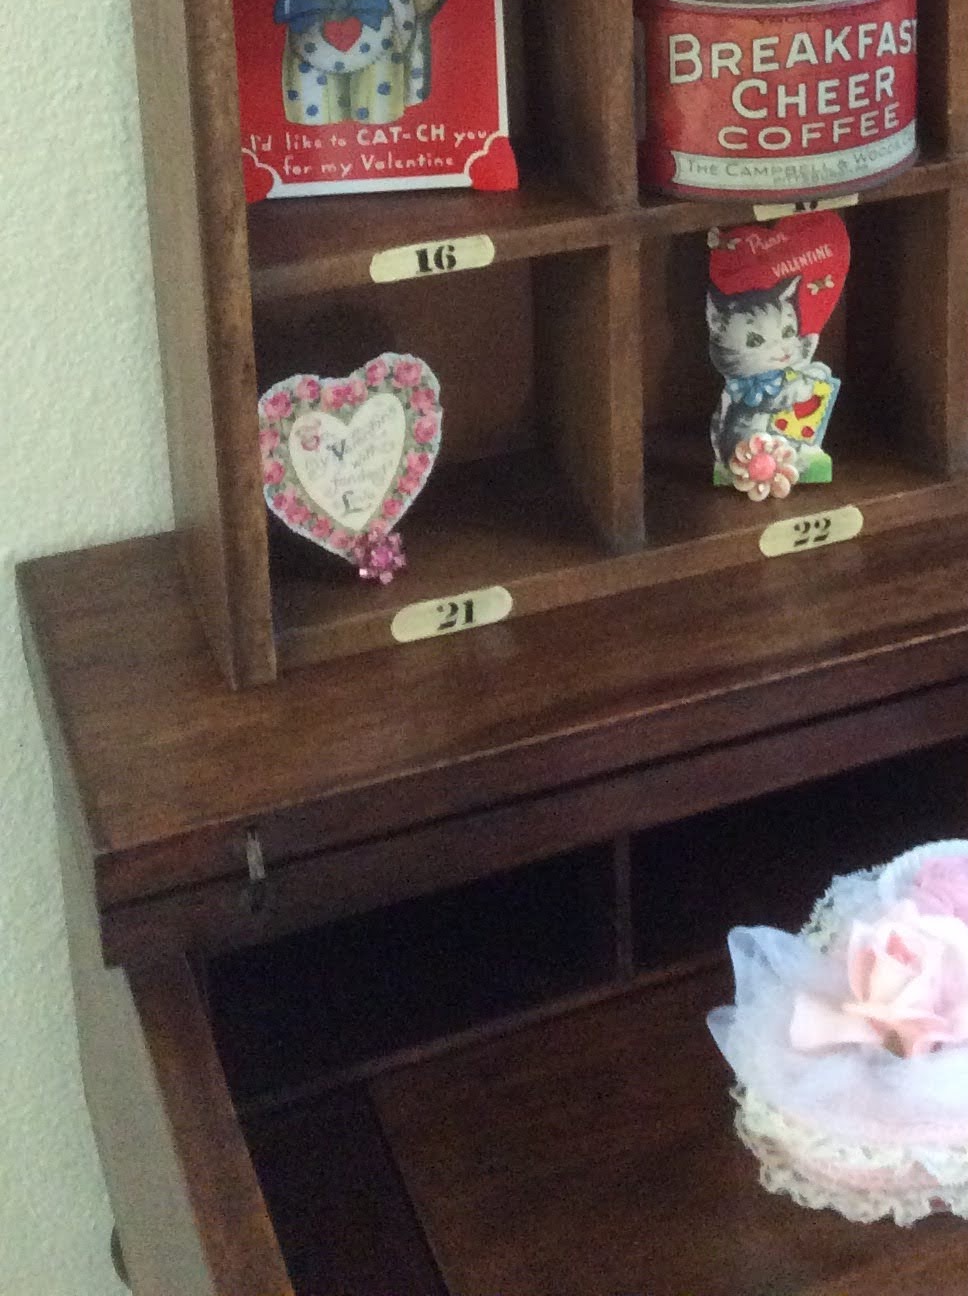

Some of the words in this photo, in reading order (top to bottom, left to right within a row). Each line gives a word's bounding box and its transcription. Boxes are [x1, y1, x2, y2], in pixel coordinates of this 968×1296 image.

[732, 65, 895, 119] CHEER
[285, 134, 322, 151] like
[331, 134, 346, 147] to
[356, 124, 445, 146] CAT-CH
[454, 131, 487, 148] you
[718, 102, 899, 150] COFFEE
[283, 159, 313, 176] for
[321, 160, 352, 178] my
[360, 151, 454, 172] Valentine
[688, 158, 718, 176] THE
[415, 245, 457, 274] 16
[771, 243, 833, 278] VALENTINE
[794, 517, 832, 548] 22
[436, 600, 474, 630] 21
